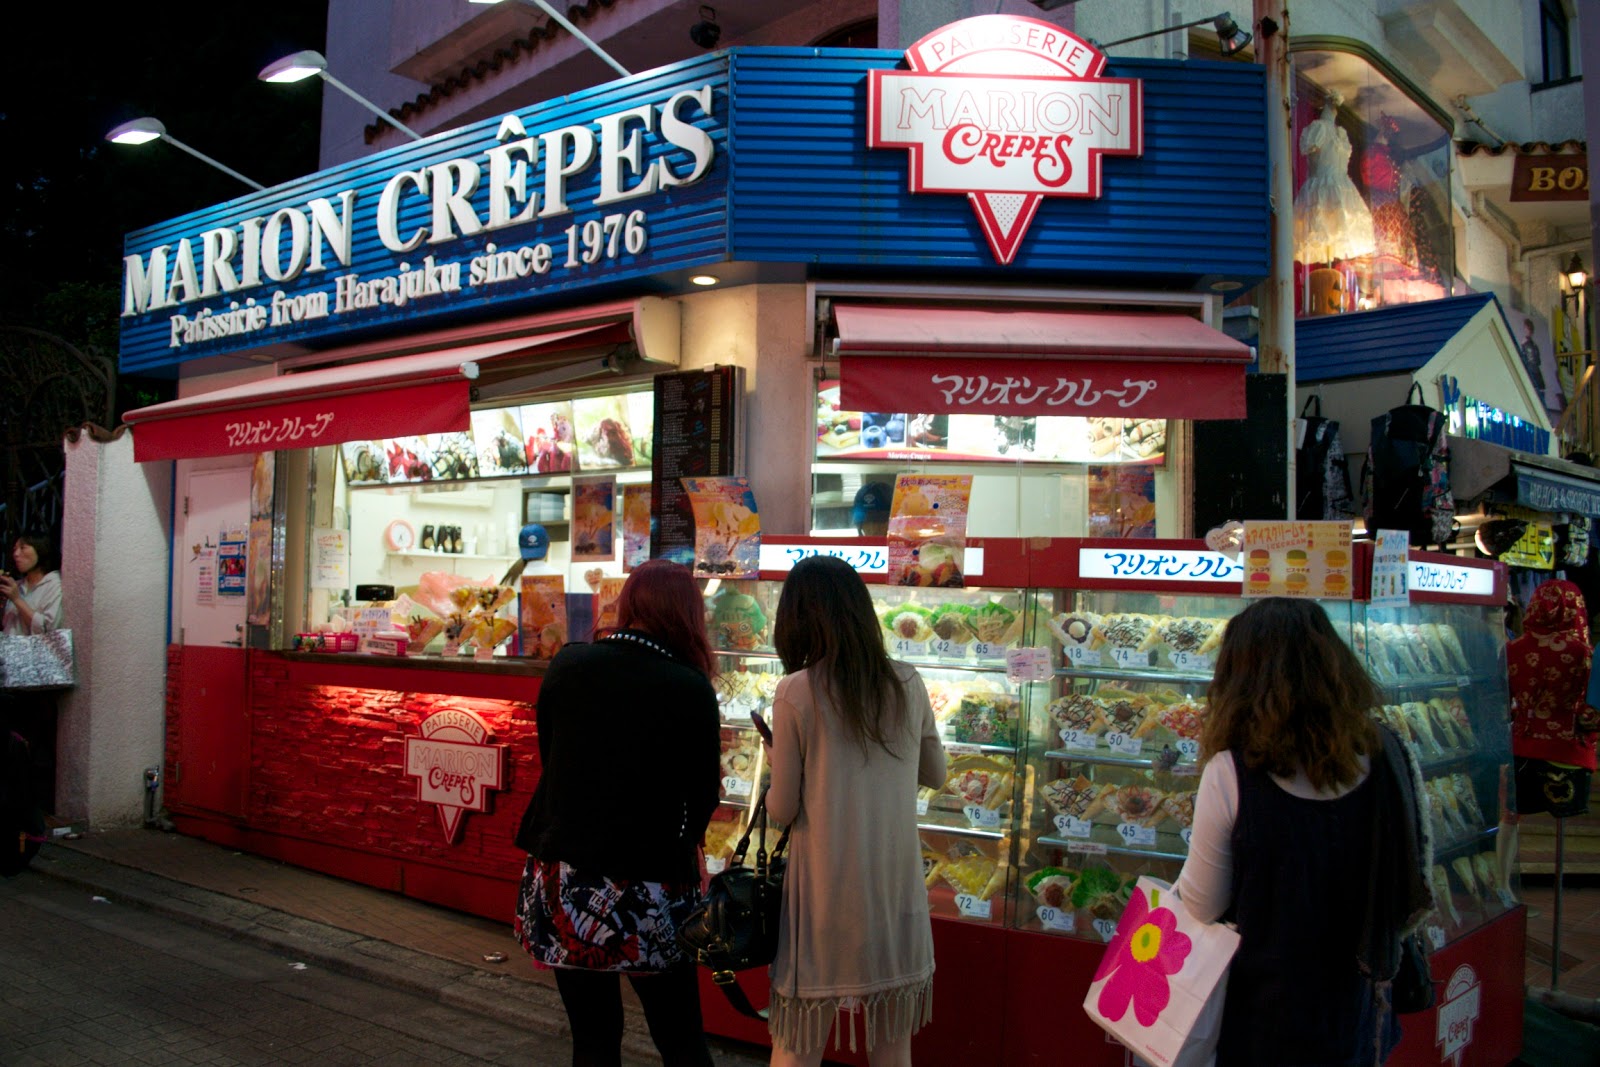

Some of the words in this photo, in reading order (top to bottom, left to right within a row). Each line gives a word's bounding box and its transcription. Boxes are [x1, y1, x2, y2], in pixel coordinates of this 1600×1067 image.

[897, 87, 1122, 136] MARION
[942, 123, 1074, 188] CREPES
[1528, 166, 1588, 191] BO
[121, 189, 357, 317] MARION
[376, 85, 714, 252] CRÊPES
[270, 290, 329, 326] from
[334, 255, 462, 314] Harajuku
[469, 243, 552, 286] since
[564, 209, 648, 268] 1976
[931, 373, 1158, 408] マリオンクレープ
[225, 411, 335, 447] マリオンクレープ
[896, 641, 909, 651] 41
[936, 641, 949, 652] 42
[976, 643, 988, 654] 65
[1069, 647, 1082, 659] 18
[1115, 649, 1129, 661] 74
[1173, 653, 1187, 664] 75
[425, 712, 482, 739] PATISSERIE
[1064, 731, 1078, 743] 22
[1109, 734, 1123, 746] 50
[1181, 742, 1195, 753] 62
[413, 745, 494, 779] MARION
[428, 766, 476, 805] CREPES
[725, 778, 737, 789] 19
[968, 808, 981, 820] 76
[1058, 817, 1071, 829] 54
[1122, 825, 1136, 837] 45
[959, 896, 972, 909] 72
[1041, 910, 1054, 921] 60
[1098, 921, 1111, 934] 70
